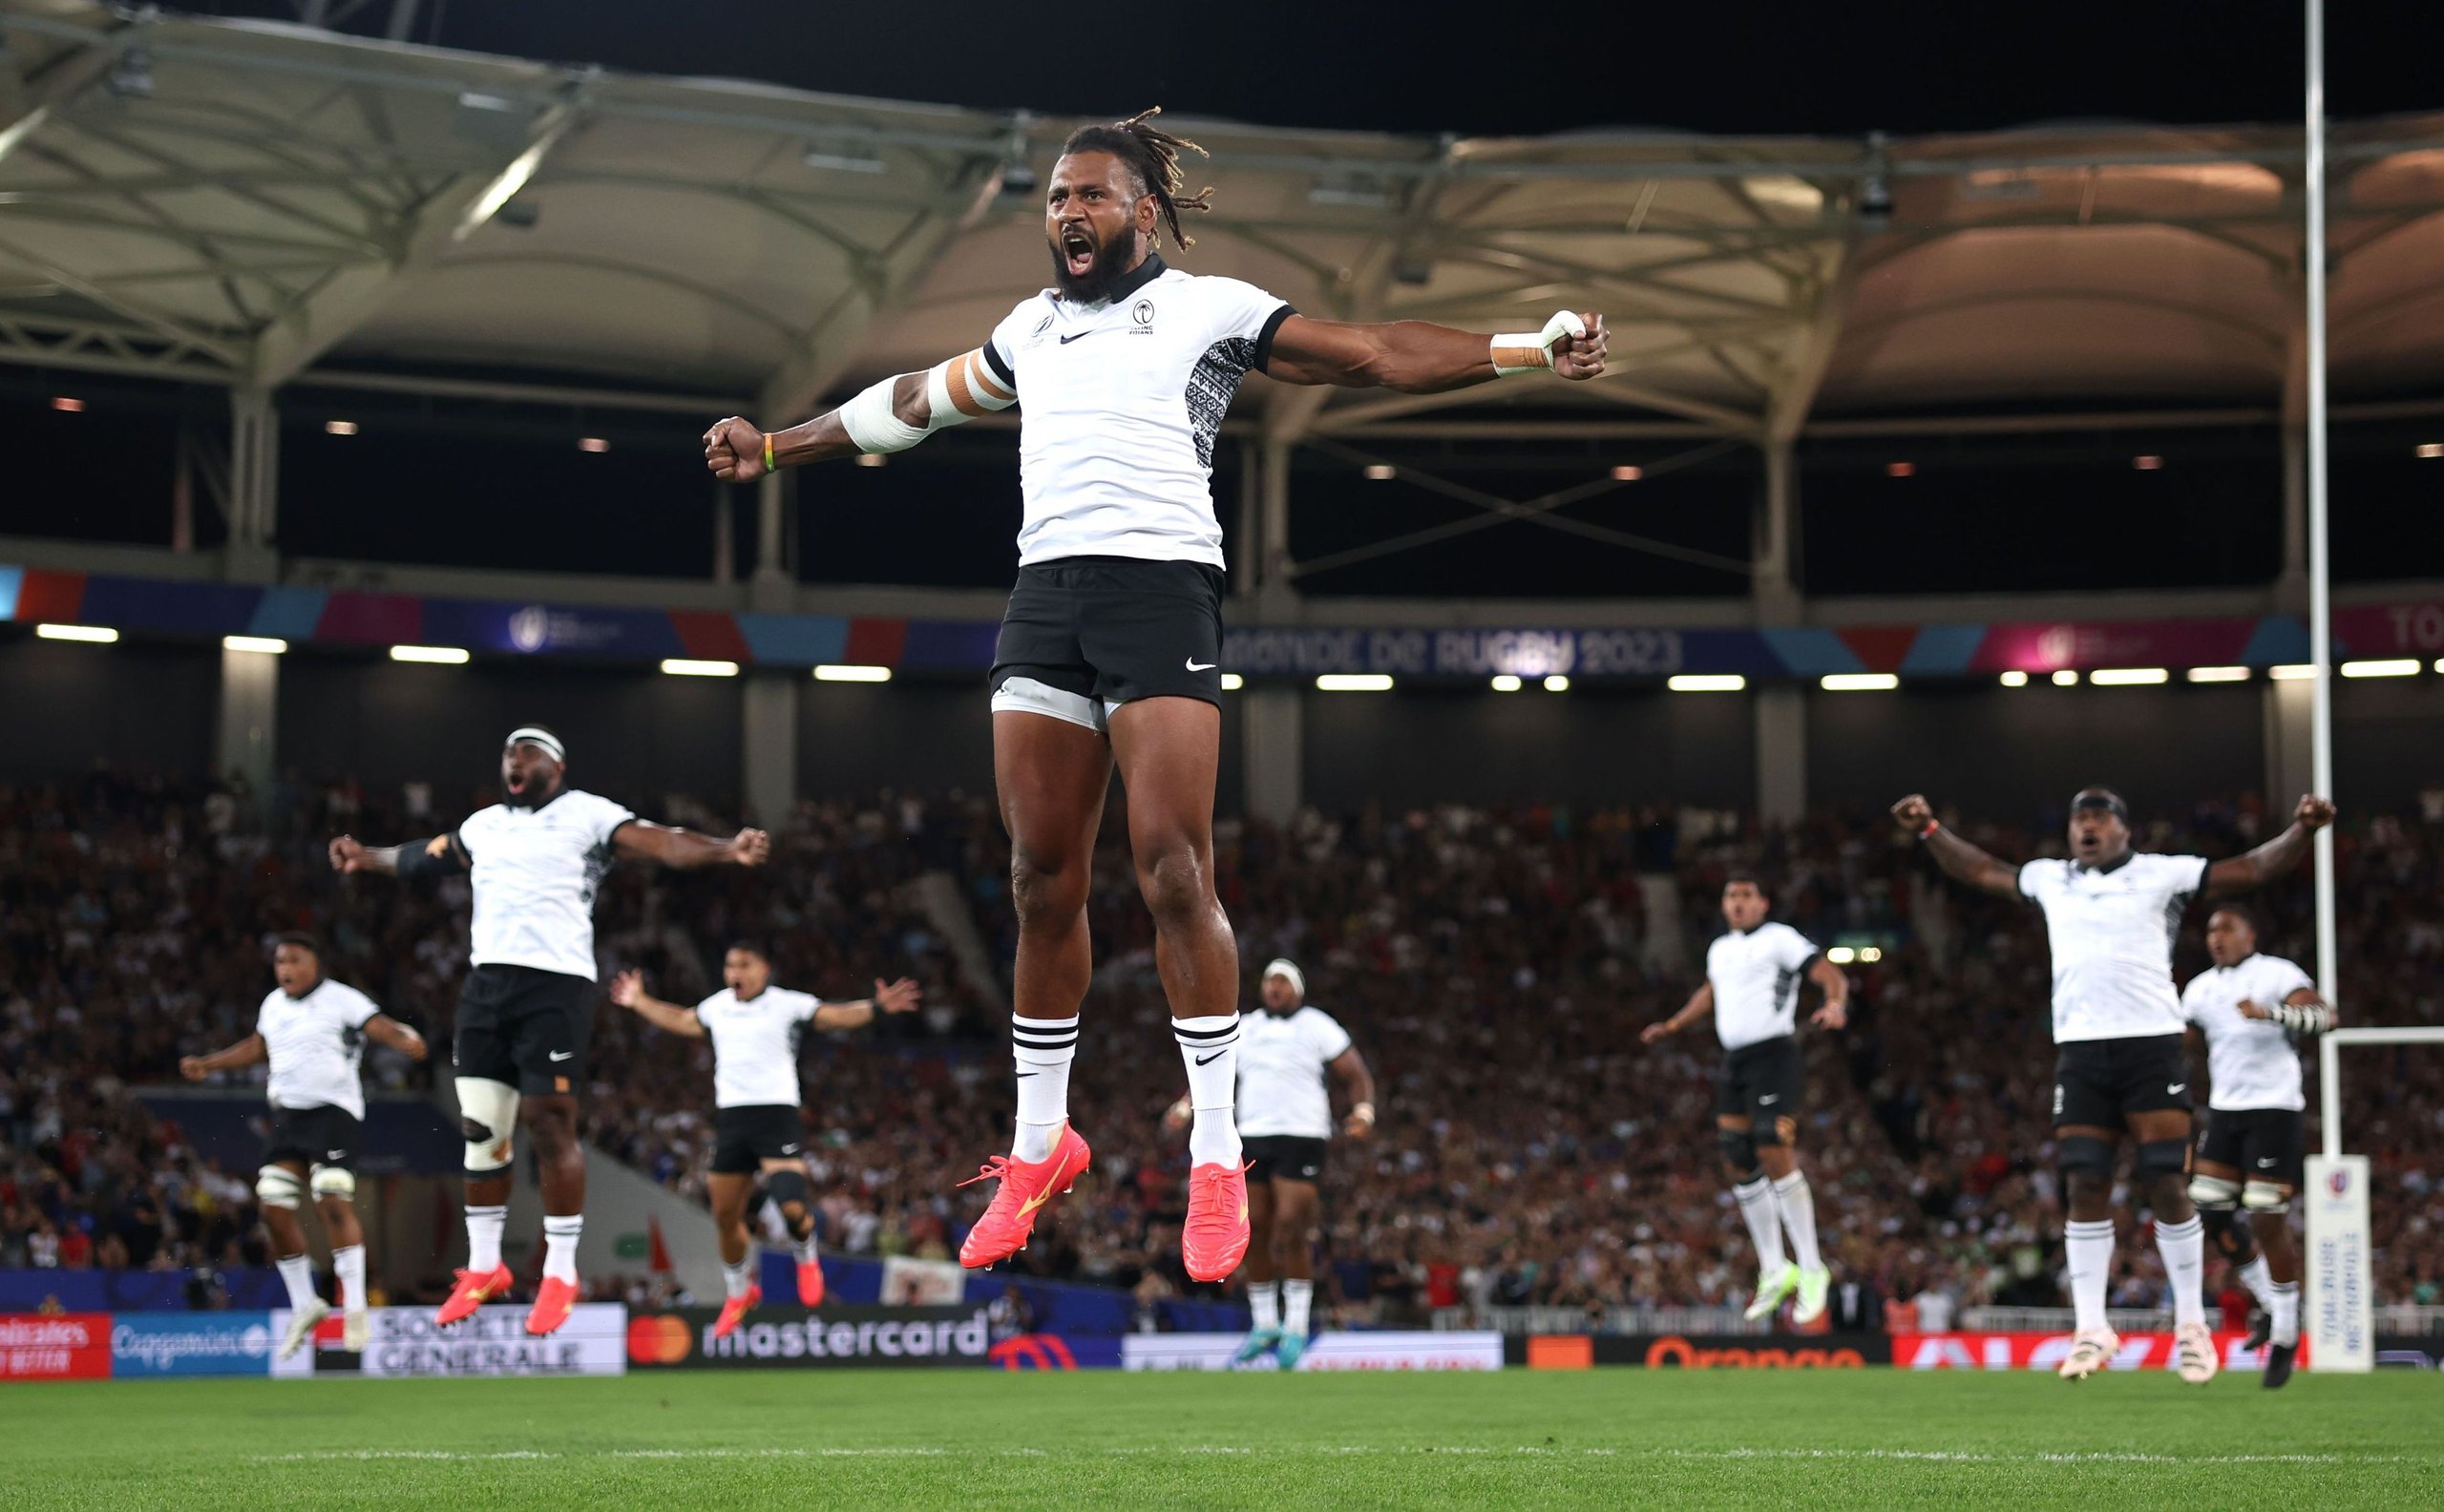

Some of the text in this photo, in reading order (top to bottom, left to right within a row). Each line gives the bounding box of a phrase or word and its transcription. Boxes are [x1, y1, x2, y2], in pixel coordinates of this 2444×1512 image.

[1435, 630, 1576, 676] RUGBY
[1581, 630, 1684, 673] 2023
[111, 1324, 238, 1370] Capgemini
[702, 1308, 989, 1358] mastercard
[380, 1343, 580, 1376] GENERALE
